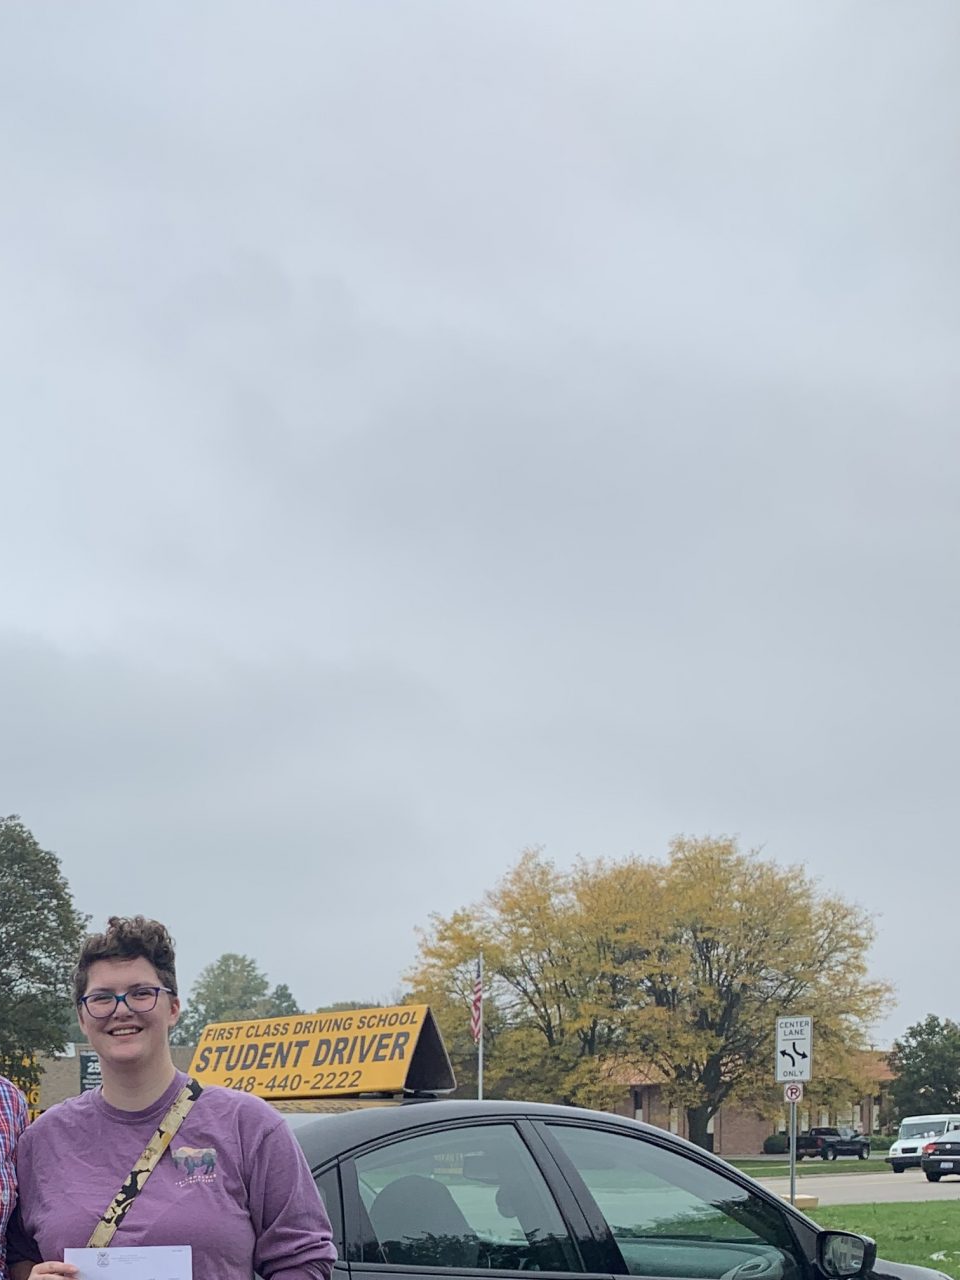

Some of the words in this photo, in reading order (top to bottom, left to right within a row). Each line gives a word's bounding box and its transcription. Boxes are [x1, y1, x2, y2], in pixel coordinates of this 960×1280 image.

[204, 1027, 243, 1042] FIRST
[245, 1022, 290, 1039] CLASS
[292, 1017, 353, 1036] DRIVING
[356, 1011, 418, 1030] SCHOOL
[779, 1020, 810, 1029] CENTER
[783, 1028, 806, 1036] LANE
[195, 1040, 311, 1073] STUDENT
[312, 1031, 411, 1067] DRIVER
[223, 1070, 363, 1093] 248-440-2222
[782, 1070, 805, 1078] ONLY
